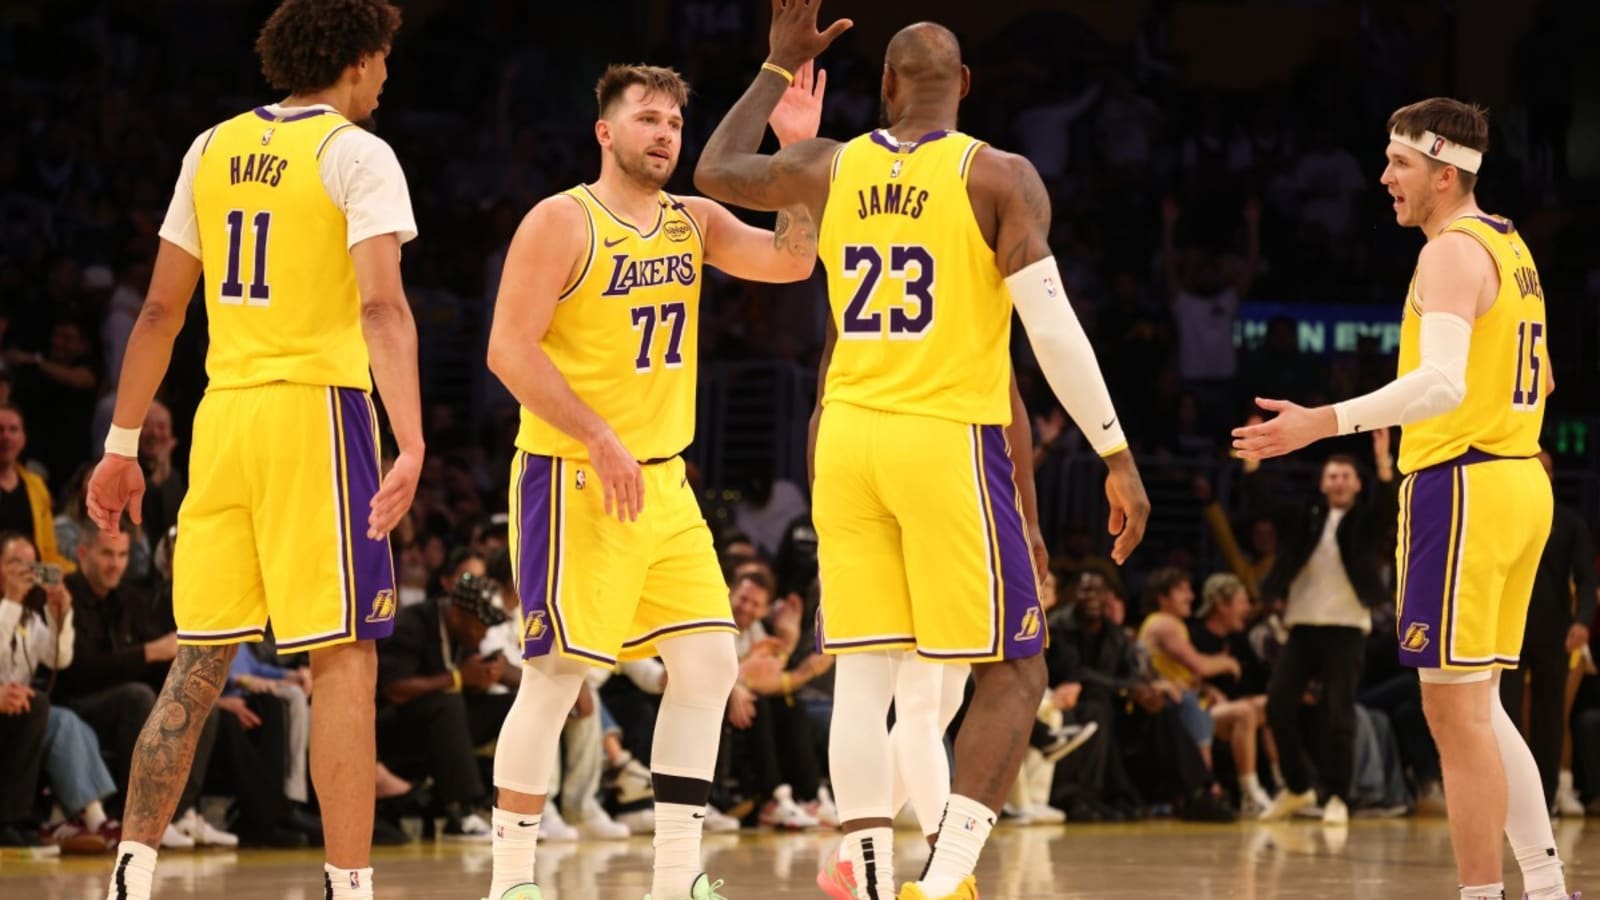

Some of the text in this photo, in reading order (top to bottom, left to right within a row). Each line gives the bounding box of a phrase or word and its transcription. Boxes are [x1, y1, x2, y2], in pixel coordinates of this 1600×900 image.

[230, 153, 288, 187] HAYES
[857, 183, 930, 220] JAMES
[220, 209, 272, 307] 11
[601, 253, 696, 297] LAKERS
[842, 244, 936, 339] 23
[630, 302, 686, 374] 77
[1512, 320, 1544, 410] 15
